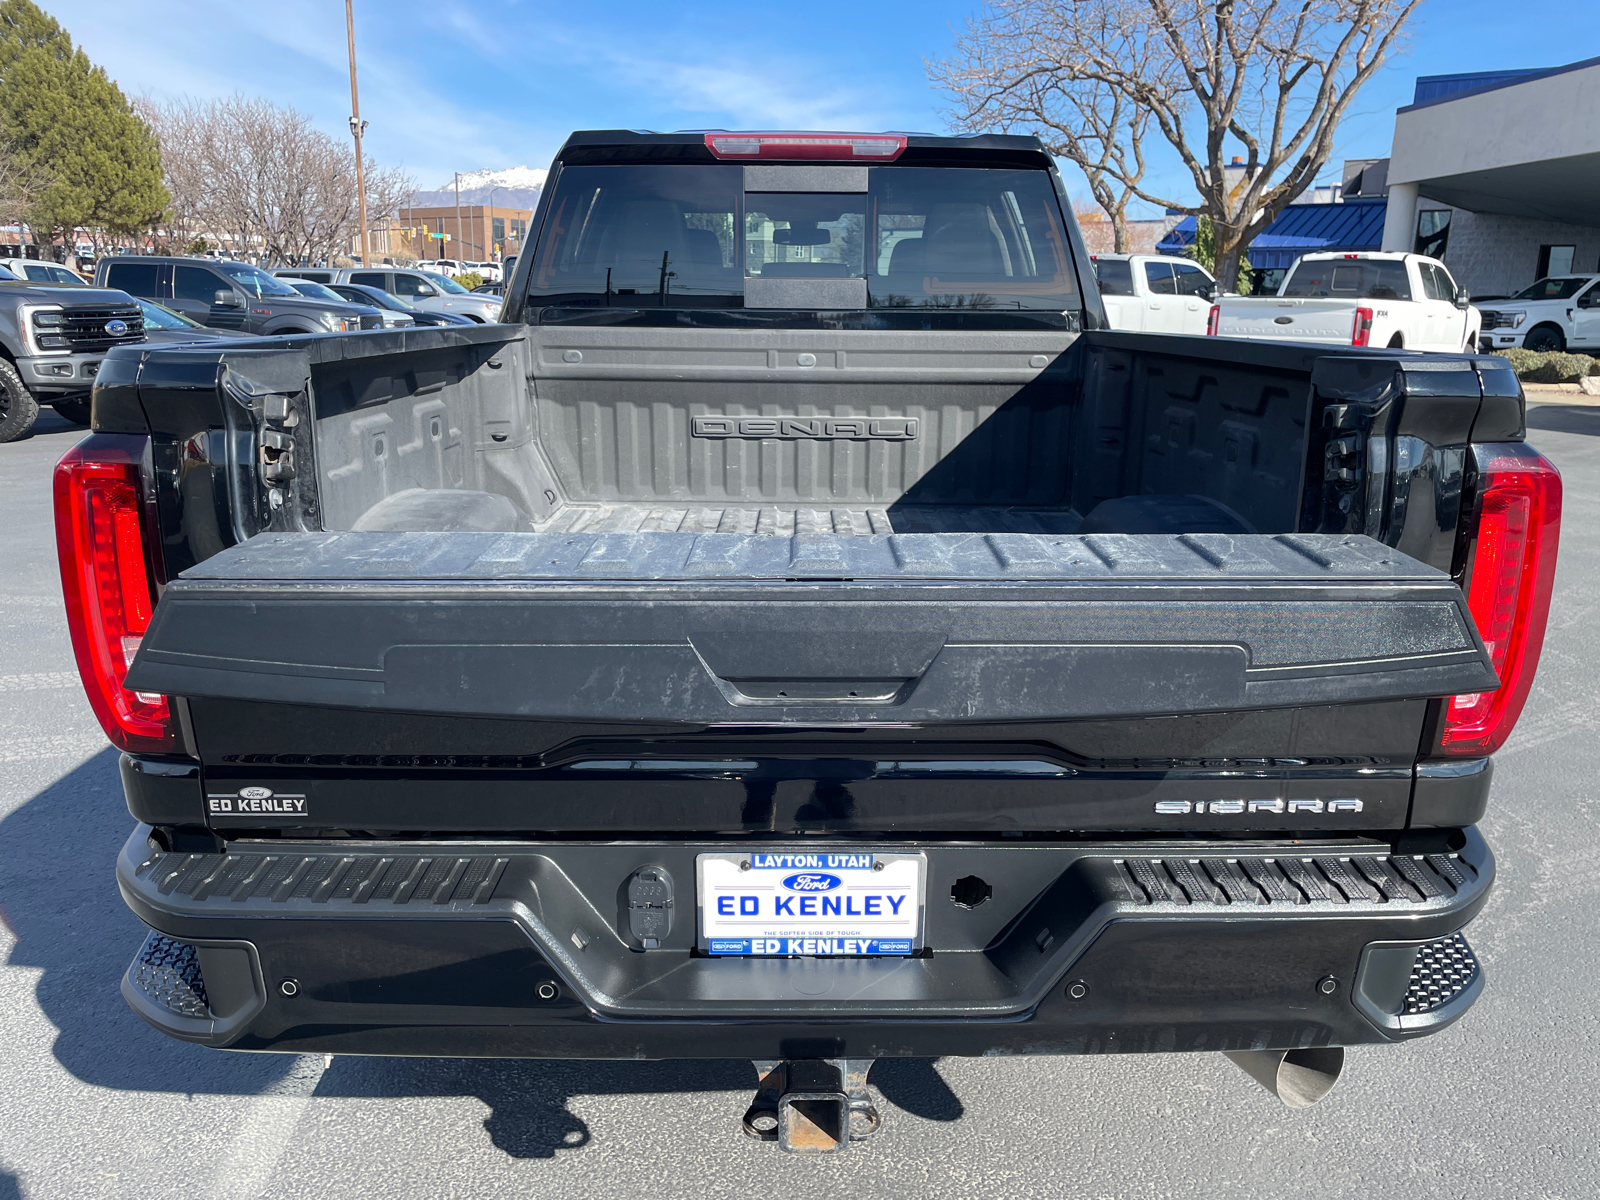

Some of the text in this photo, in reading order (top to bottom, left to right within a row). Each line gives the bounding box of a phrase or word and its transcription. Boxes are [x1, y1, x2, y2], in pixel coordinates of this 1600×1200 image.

[1224, 326, 1344, 336] SUPER DUTY
[694, 419, 916, 437] DENALI
[247, 789, 265, 798] Ford
[209, 799, 305, 812] ED KENLEY
[1154, 799, 1363, 814] SIERRA
[754, 855, 870, 868] LAYTON, UTAH
[794, 874, 831, 891] Ford
[717, 895, 907, 916] ED KENLEY
[751, 939, 872, 954] ED KENLEY
